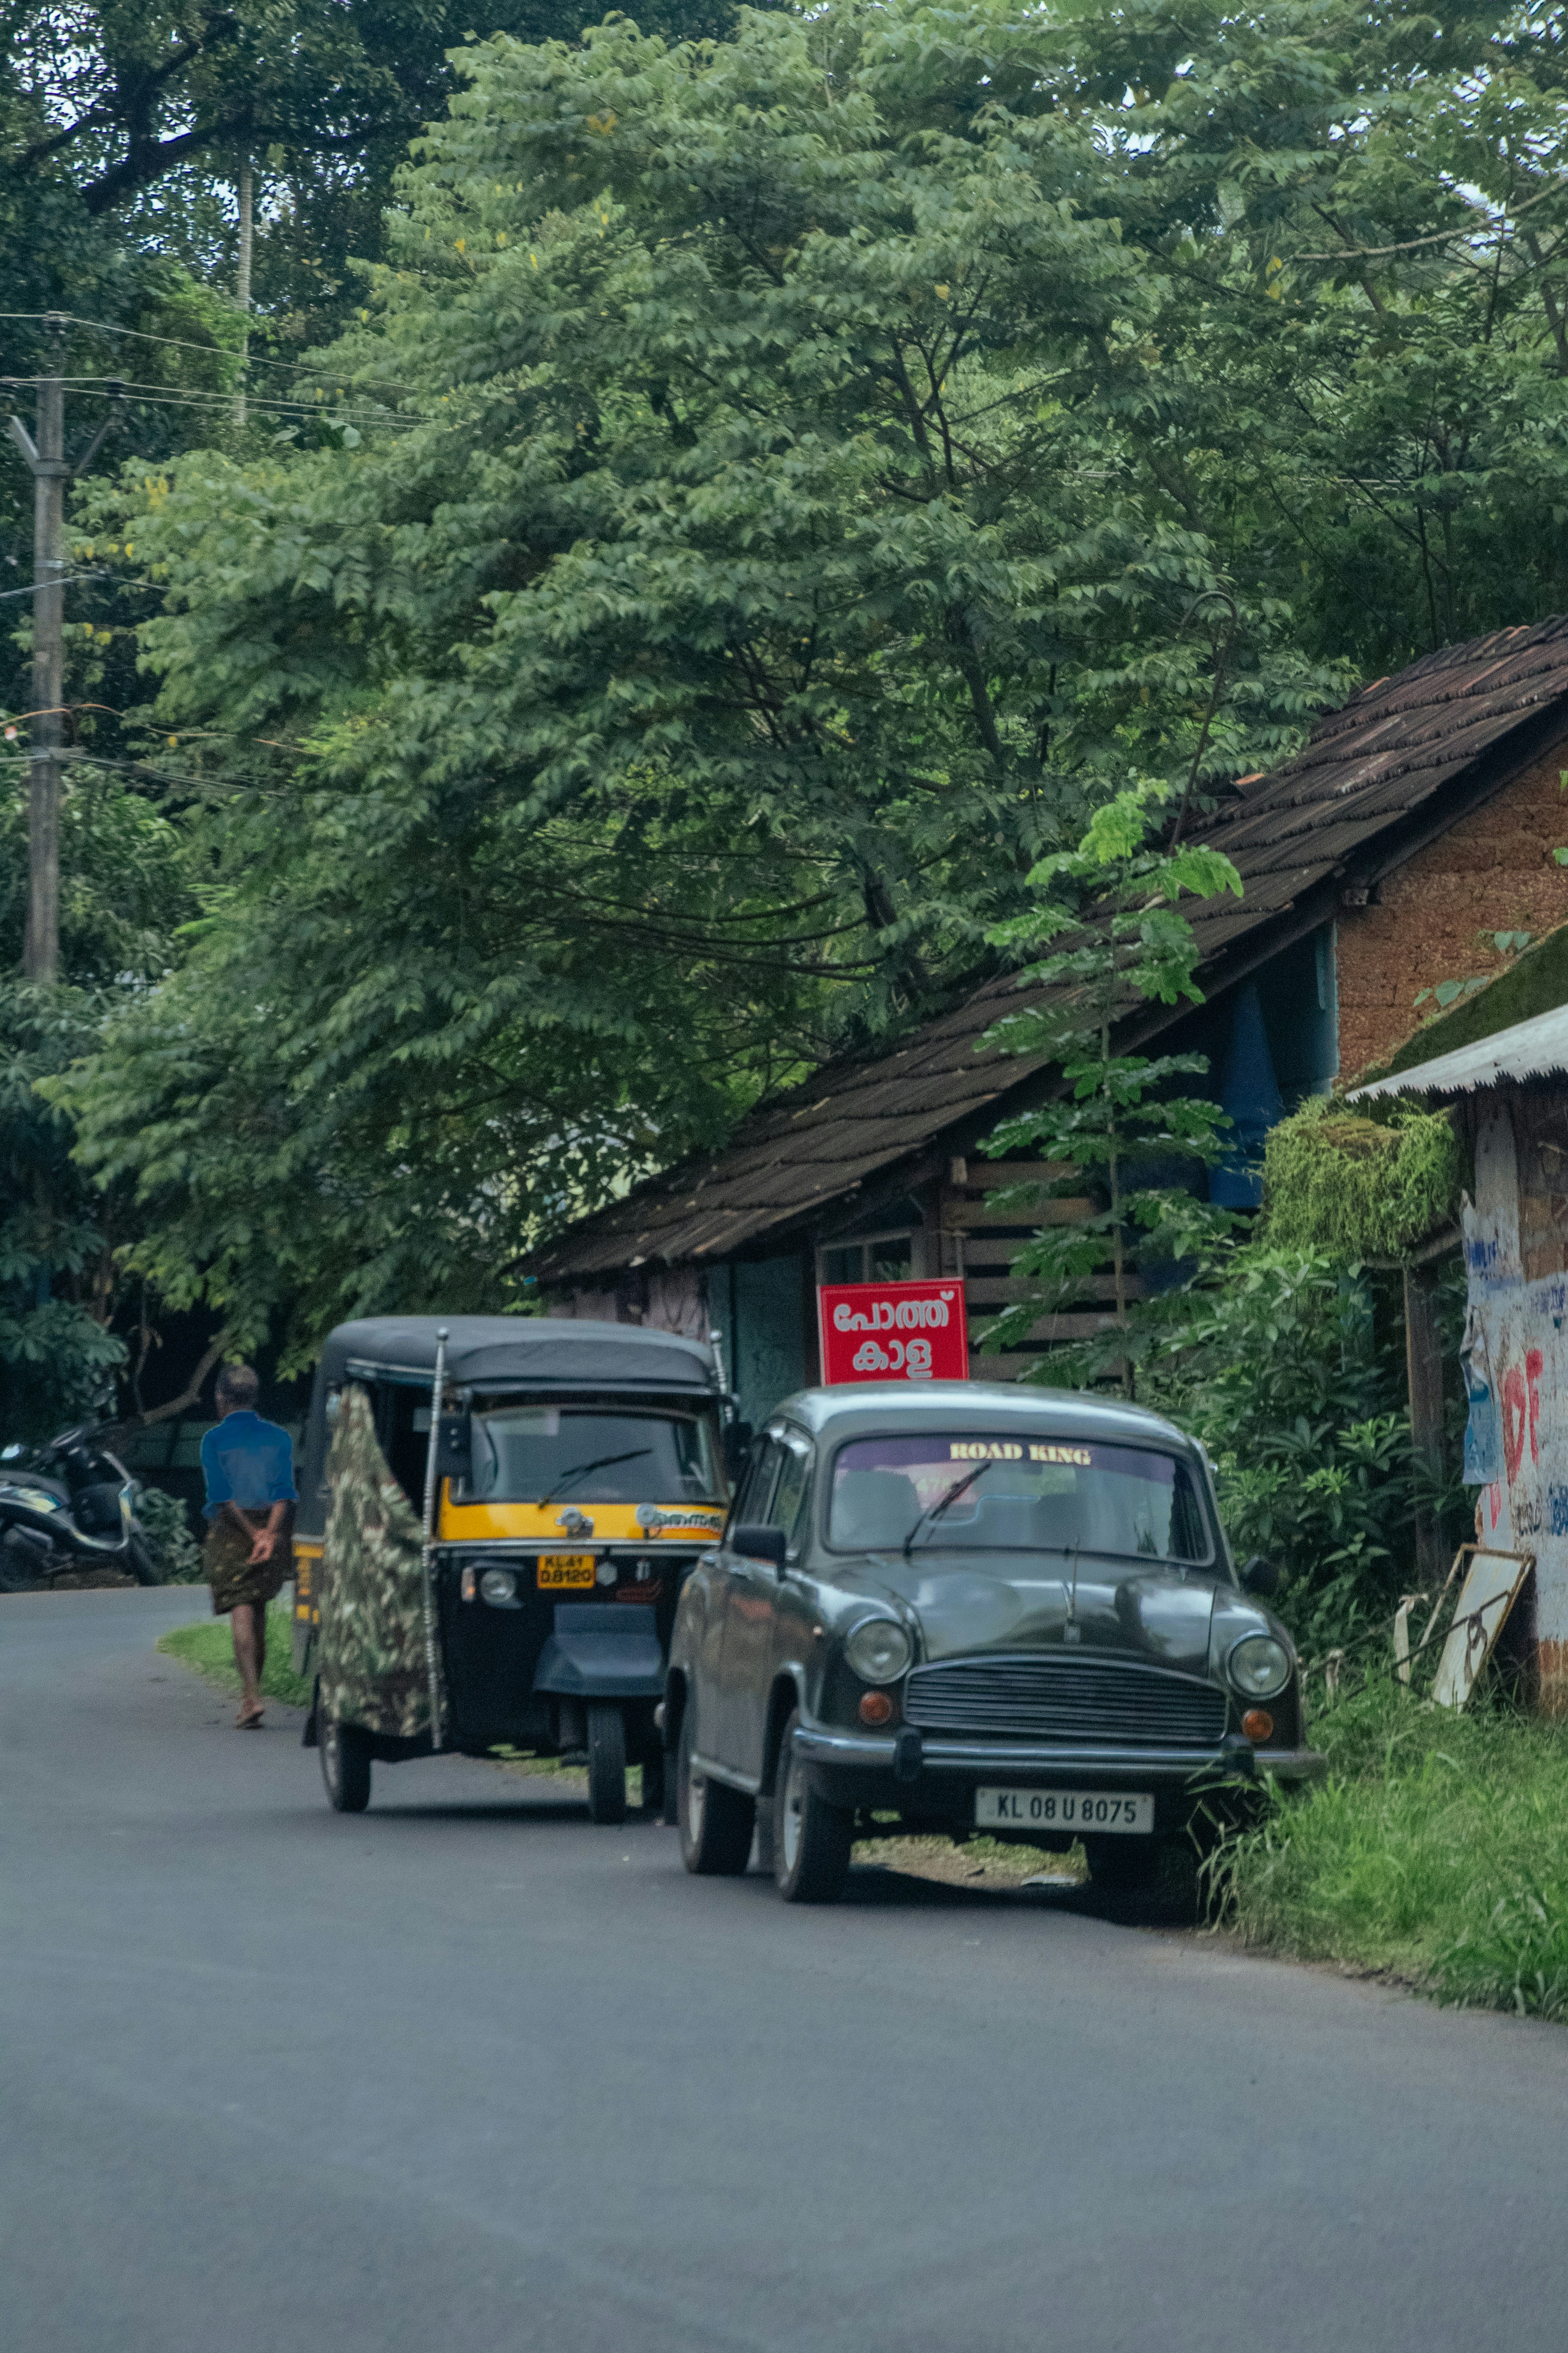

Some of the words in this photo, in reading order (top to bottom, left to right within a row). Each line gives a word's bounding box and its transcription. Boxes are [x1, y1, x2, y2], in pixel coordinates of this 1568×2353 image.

[833, 1291, 954, 1332] പോത്ത്
[852, 1339, 932, 1378] കാള
[950, 1443, 1023, 1459] ROAD
[1029, 1444, 1091, 1465] KING
[997, 1794, 1023, 1819] KL
[1031, 1796, 1056, 1820] 08
[1062, 1797, 1075, 1820] U
[1081, 1800, 1136, 1823] 8075
